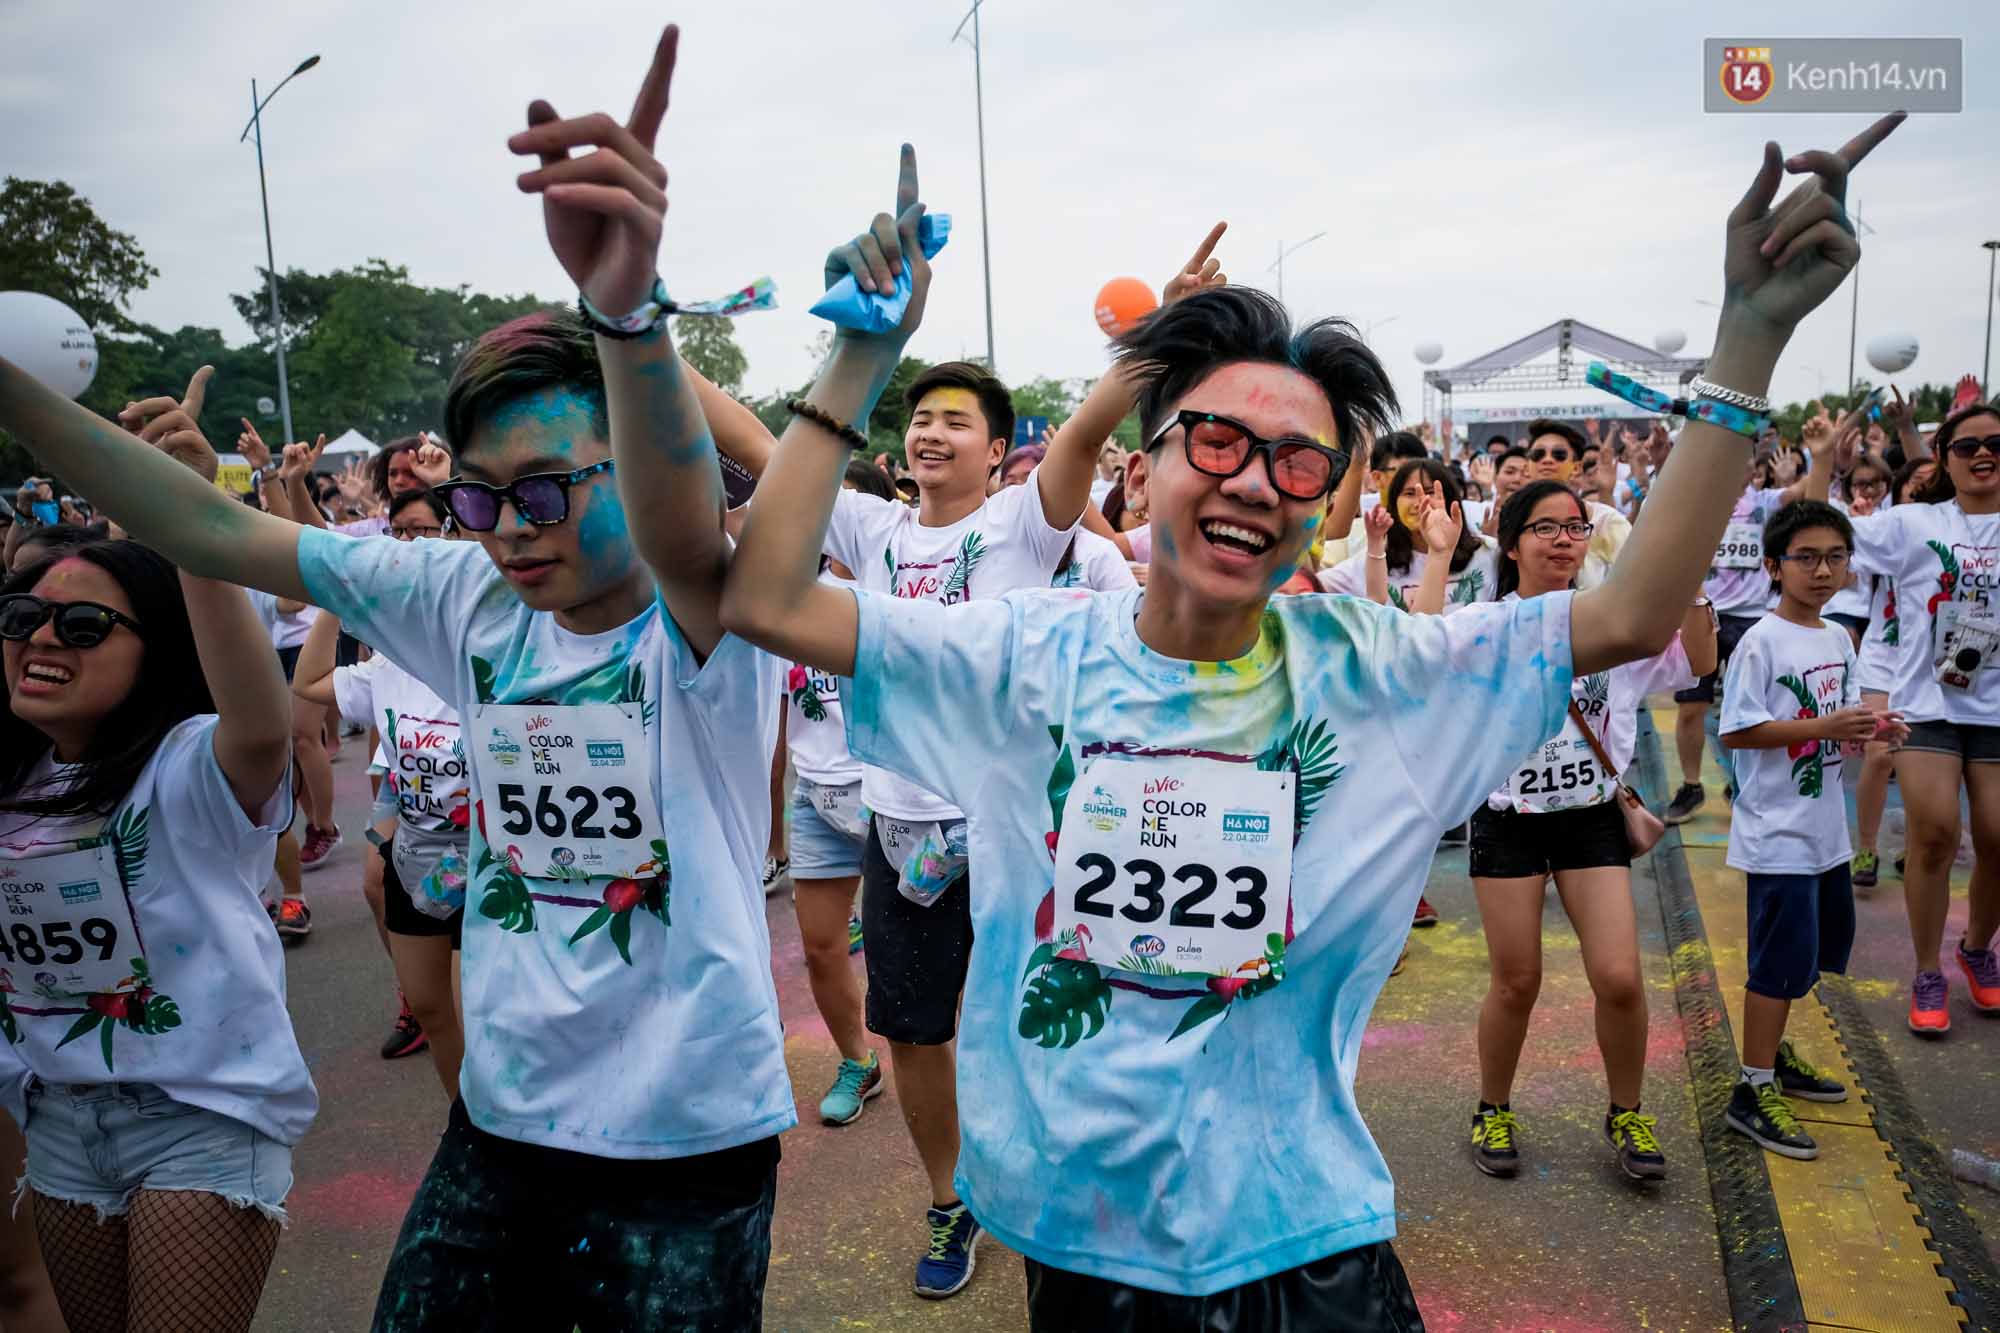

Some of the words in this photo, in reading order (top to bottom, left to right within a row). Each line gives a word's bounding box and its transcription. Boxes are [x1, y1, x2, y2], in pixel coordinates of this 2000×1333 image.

[1717, 543, 1759, 558] 5988
[1961, 573, 2000, 589] COL
[812, 676, 838, 694] RU
[529, 735, 574, 749] COLOR
[531, 748, 552, 761] ME
[534, 762, 561, 775] RUN
[400, 774, 433, 793] ME
[1519, 760, 1595, 795] 2155
[498, 783, 643, 839] 5623
[1082, 802, 1128, 818] SUMMER
[1143, 799, 1207, 817] COLOR
[1141, 815, 1169, 832] ME
[1140, 831, 1176, 849] RUN
[1, 882, 46, 894] COLOR
[1073, 853, 1268, 930] 2323
[9, 904, 34, 916] RUN
